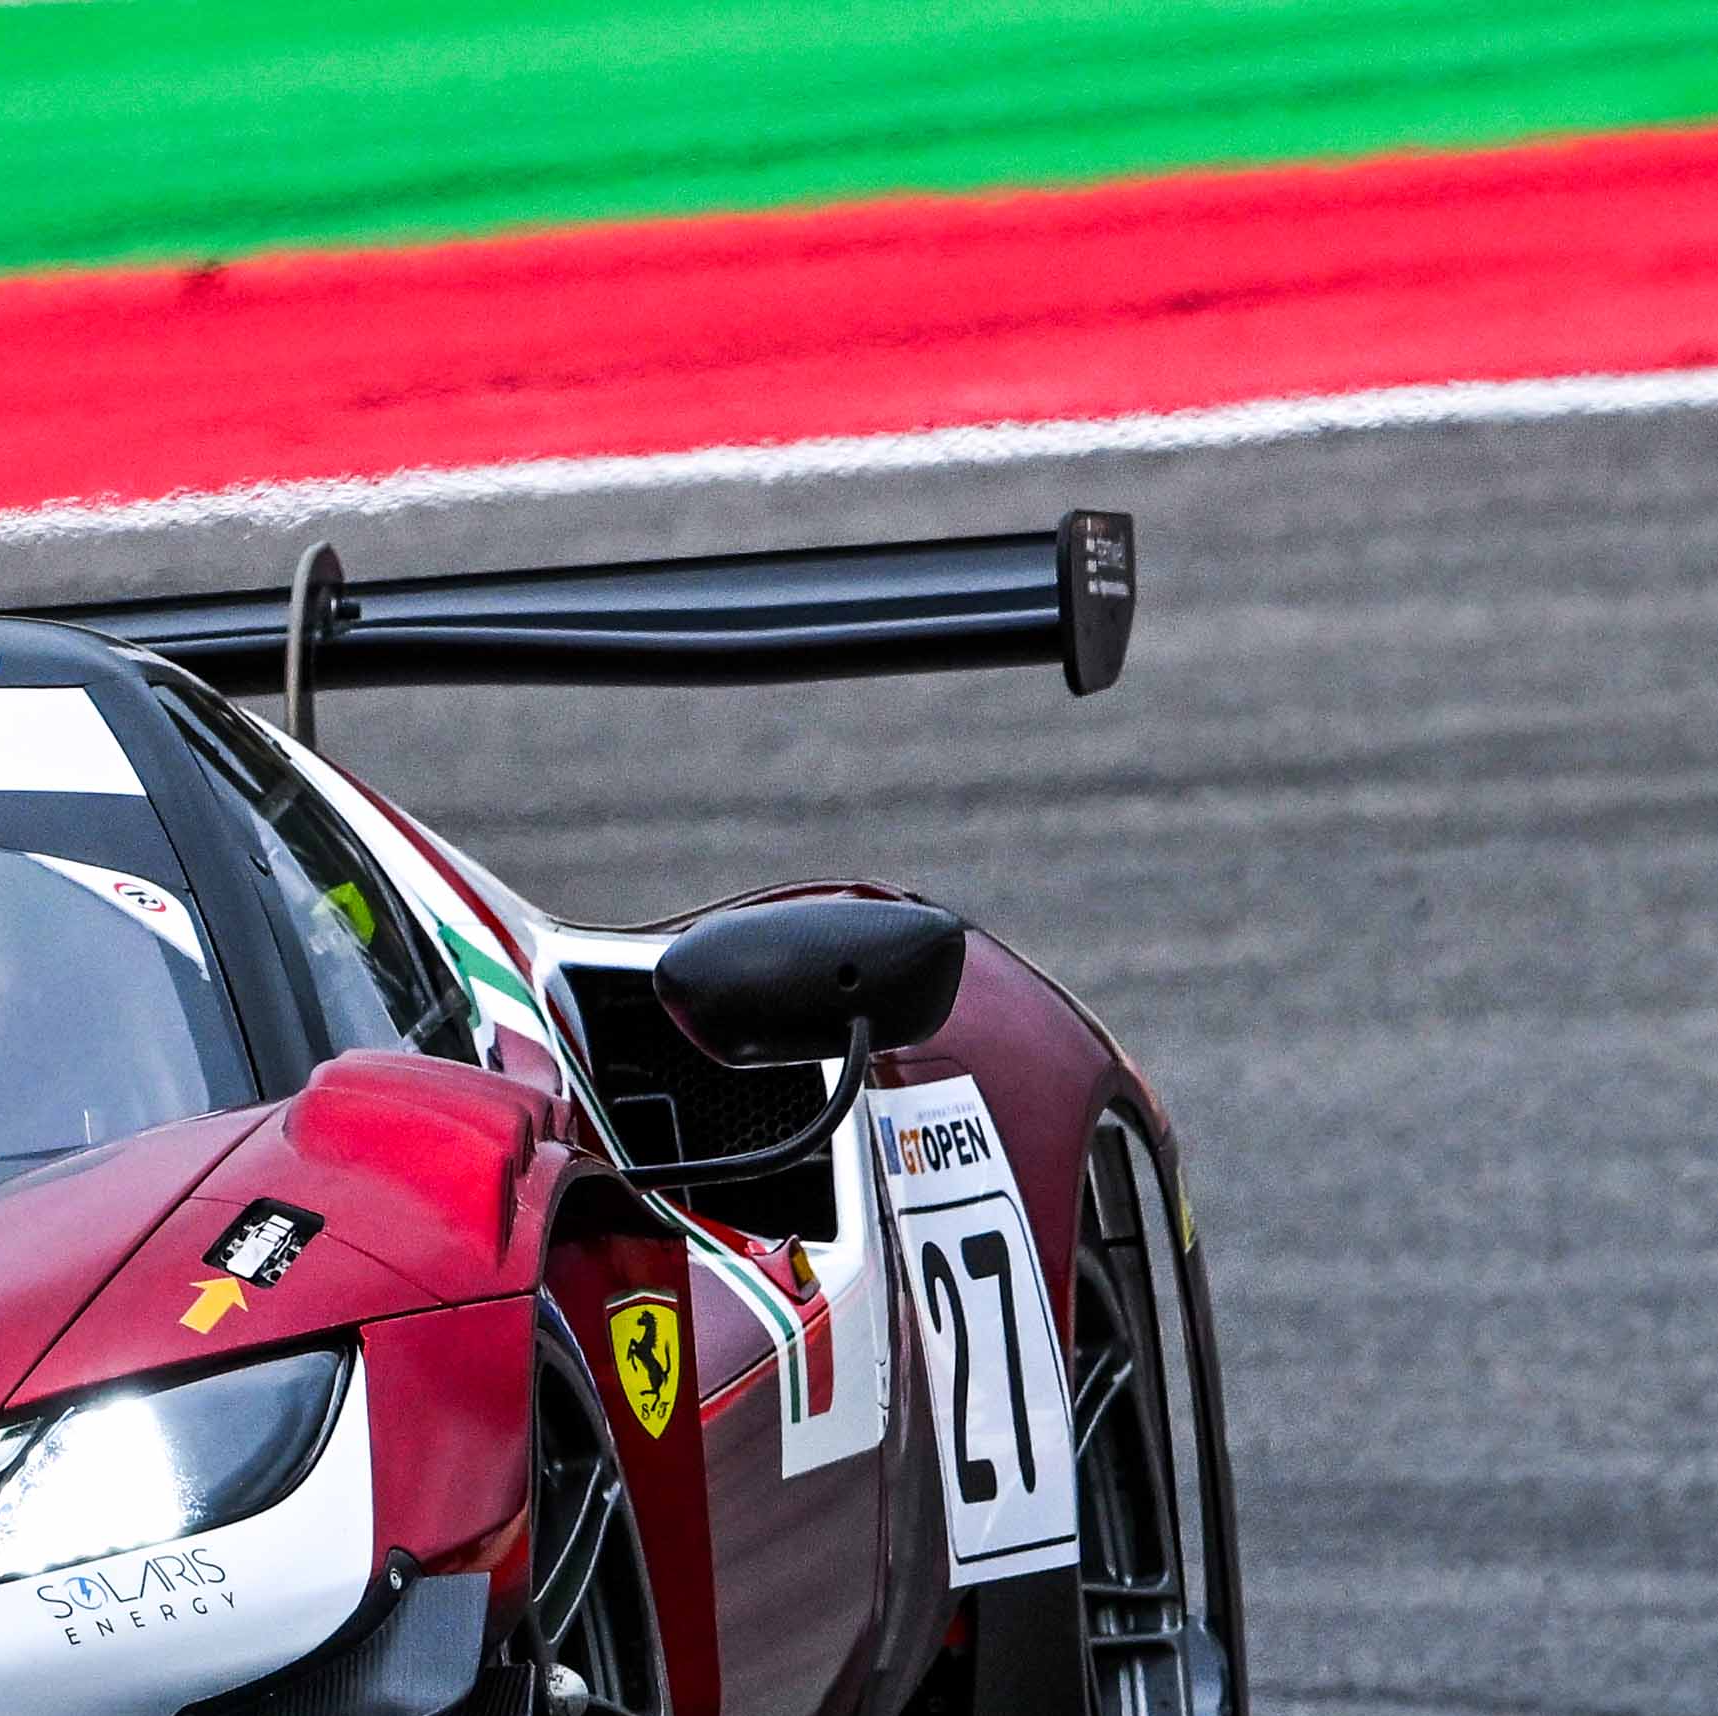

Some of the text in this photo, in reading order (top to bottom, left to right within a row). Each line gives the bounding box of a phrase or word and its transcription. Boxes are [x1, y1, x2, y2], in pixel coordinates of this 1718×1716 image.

[921, 1230, 1036, 1503] 27
[36, 1547, 226, 1620] SOLARIS
[64, 1591, 236, 1646] ENERGY
